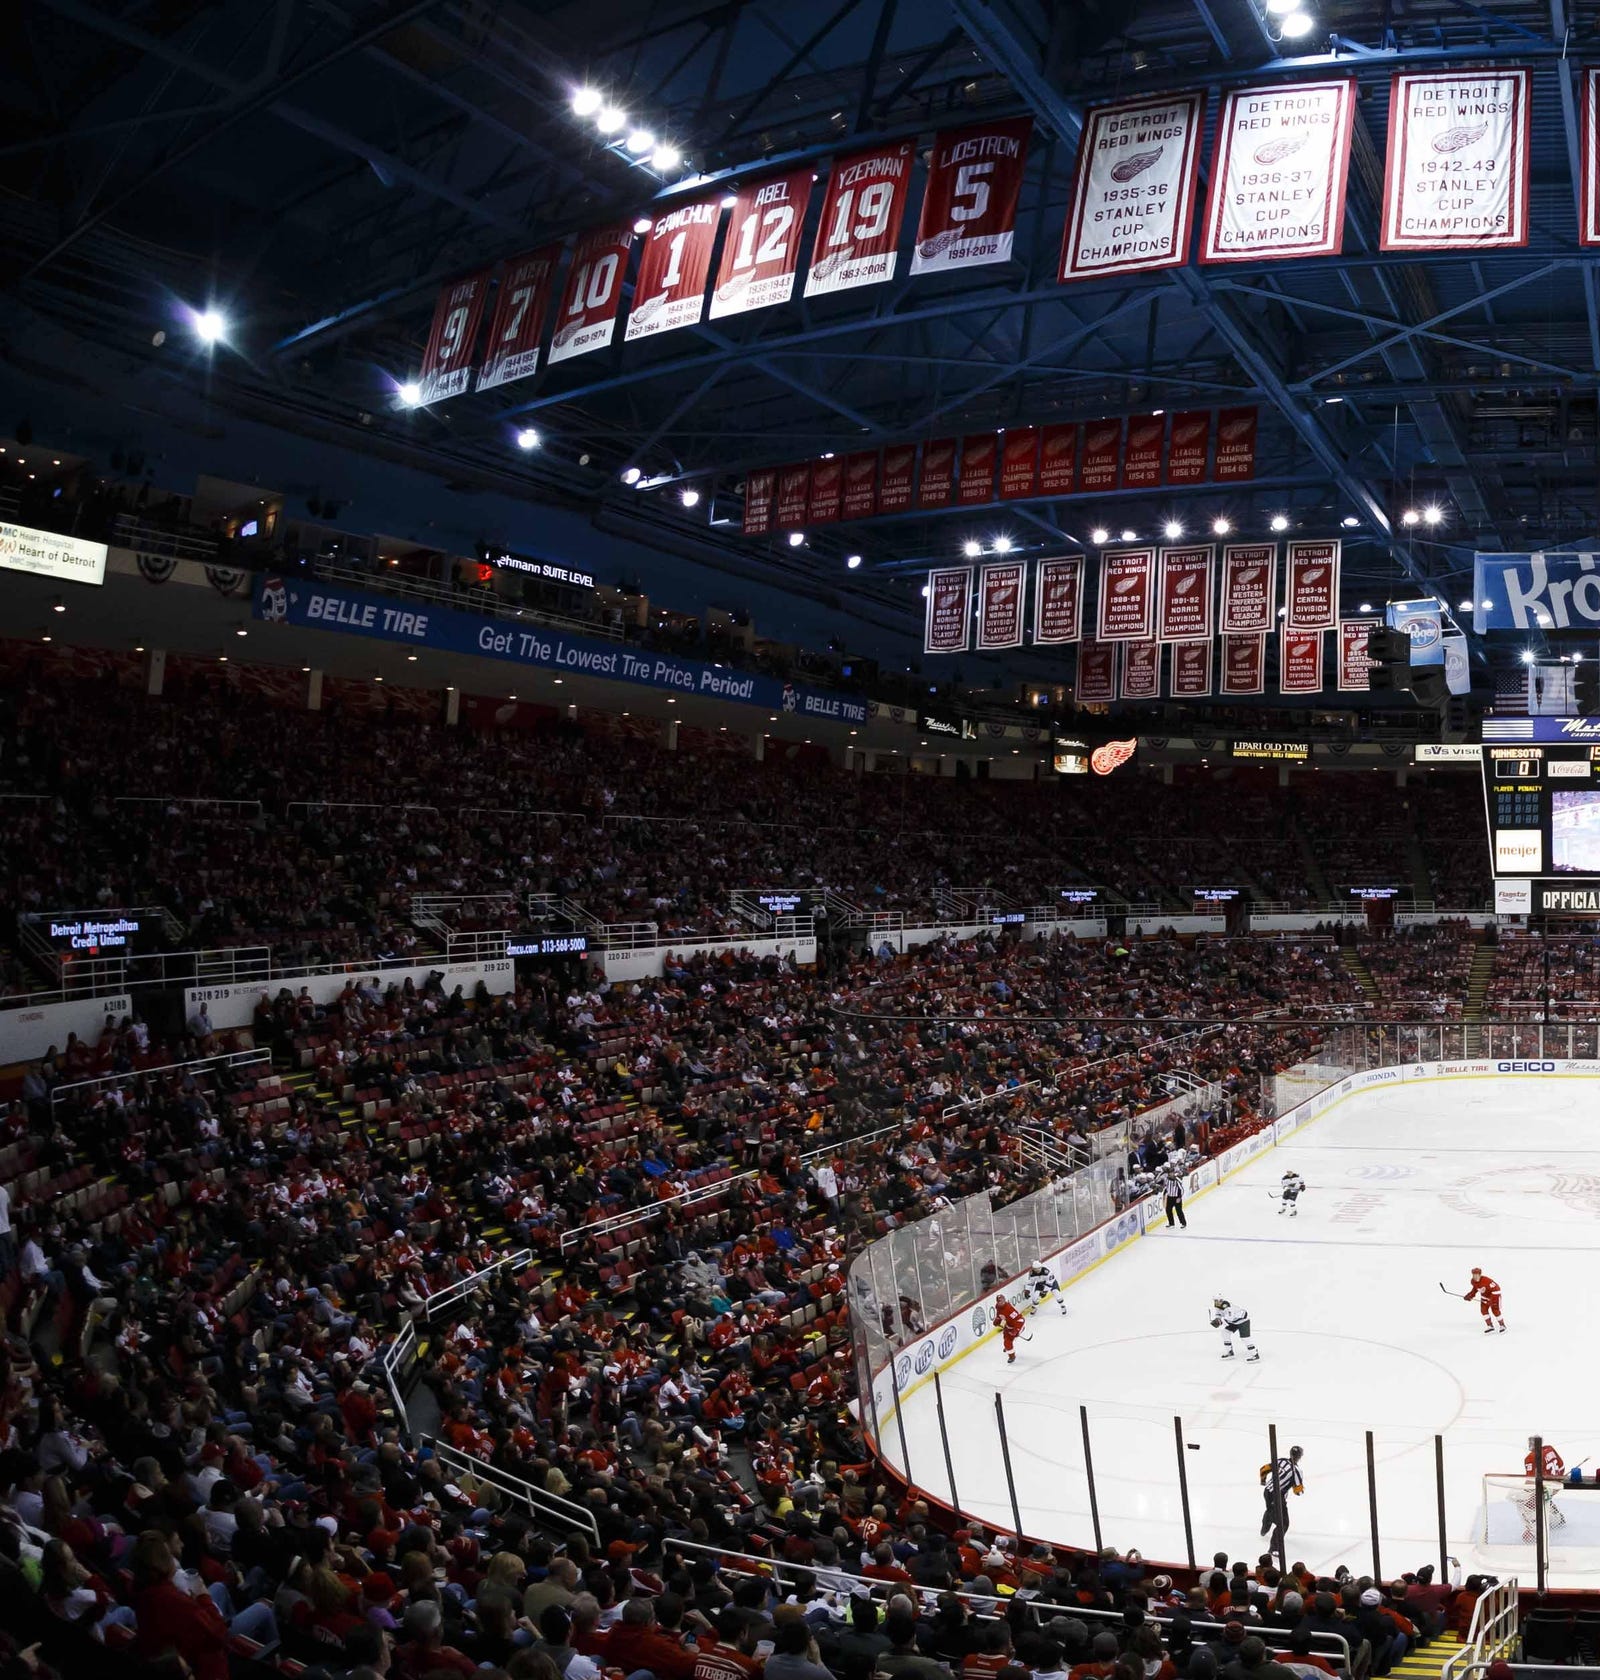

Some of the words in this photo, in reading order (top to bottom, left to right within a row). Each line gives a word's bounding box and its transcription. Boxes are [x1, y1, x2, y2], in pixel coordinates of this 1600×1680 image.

[1423, 86, 1499, 100] DETROIT
[1413, 104, 1446, 117] RED
[1458, 101, 1509, 115] WINGS
[1108, 110, 1178, 133] DETROIT
[1099, 132, 1129, 149] RED
[1136, 126, 1182, 144] WINGS
[940, 135, 1020, 168] LIDSTROM
[839, 157, 903, 190] YZERMAN
[1421, 160, 1495, 173] 1942-43
[951, 162, 995, 222] 5
[1103, 183, 1168, 202] 1935-36
[1417, 178, 1497, 192] STANLEY
[754, 181, 789, 208] ABEL
[1094, 201, 1166, 222] STANLEY
[1438, 198, 1473, 211] CUP
[653, 204, 716, 240] SAWCHUK
[827, 181, 895, 247] 19
[1405, 214, 1505, 230] CHAMPIONS
[732, 204, 794, 270] 12
[1112, 223, 1144, 238] CUP
[948, 244, 997, 259] 1991-2012
[1081, 236, 1170, 260] CHAMPIONS
[662, 231, 686, 288] 1
[839, 263, 885, 281] 1983-2006
[568, 253, 619, 316] 10
[504, 285, 535, 341] 7
[440, 307, 469, 359] 9
[19, 544, 45, 558] Heart
[48, 552, 58, 560] of
[62, 553, 96, 568] Detroit
[542, 564, 569, 581] SUITE
[569, 571, 595, 588] LEVEL
[307, 596, 377, 628] BELLE
[383, 608, 428, 637] TIRE
[478, 626, 513, 653] Get
[519, 633, 551, 660] The
[556, 642, 617, 673] Lowest
[622, 654, 650, 680] Tire
[654, 660, 695, 691] Price,
[700, 671, 754, 699] Period!
[805, 695, 838, 715] BELLE
[841, 701, 865, 720] TIRE
[1234, 742, 1262, 751] LIPARI
[1264, 743, 1281, 751] OLD
[1490, 749, 1542, 758] MINNESOTA
[1518, 761, 1528, 776] 0
[1500, 845, 1537, 857] meijer
[1498, 891, 1527, 900] Flagstar
[51, 922, 81, 936] Detroit
[84, 920, 138, 936] Metropolitan
[72, 935, 97, 948] Credit
[100, 934, 125, 946] Union
[507, 944, 538, 956] dmcu.com
[541, 938, 585, 952] 313-568-5000
[484, 963, 495, 972] 219
[497, 962, 510, 971] 220
[214, 989, 229, 999] 219
[1445, 1065, 1468, 1073] BELLE
[1497, 1062, 1555, 1072] GEICO
[1366, 1071, 1397, 1083] HONDA
